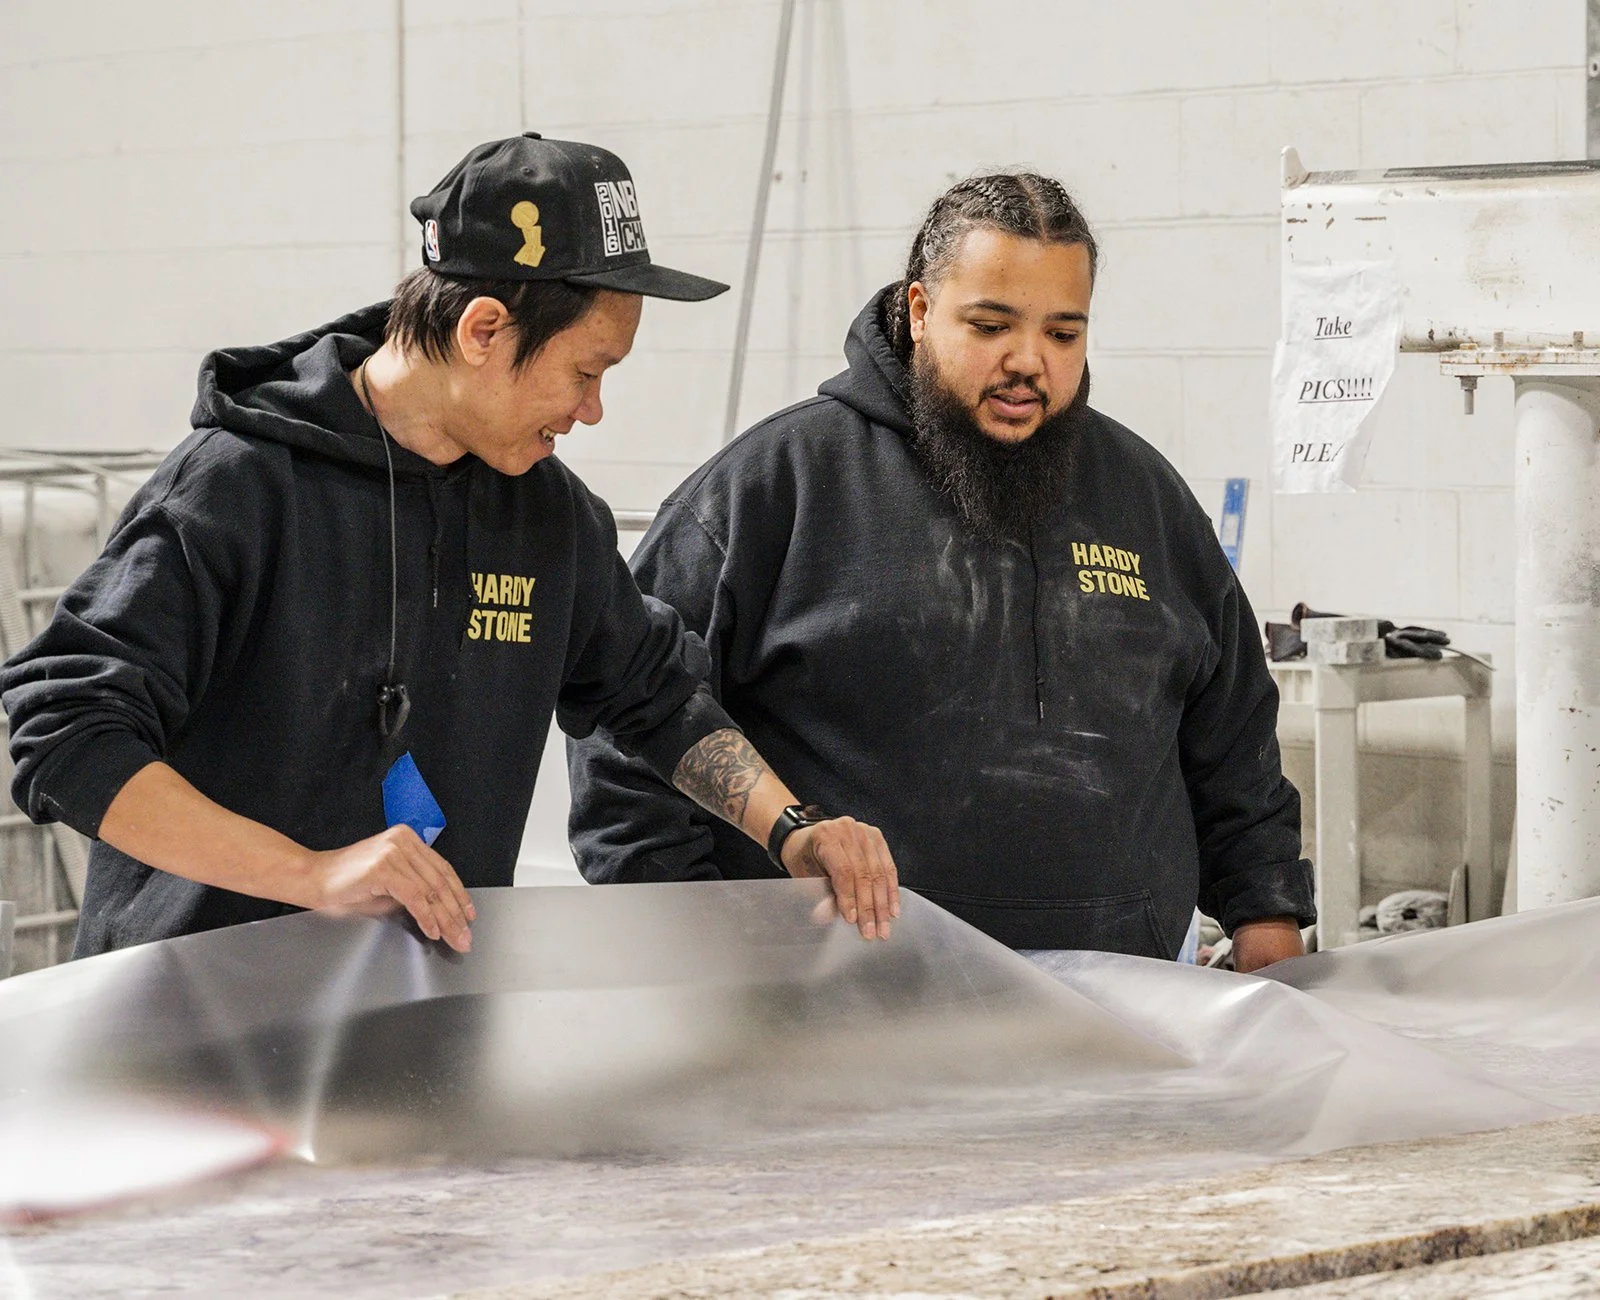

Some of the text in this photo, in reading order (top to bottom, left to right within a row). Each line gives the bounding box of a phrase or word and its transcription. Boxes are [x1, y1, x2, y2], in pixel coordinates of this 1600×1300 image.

[597, 185, 619, 253] 2016
[1315, 316, 1353, 338] Take
[1299, 377, 1373, 401] PICS!!!!
[1071, 542, 1141, 576] HARDY
[1078, 569, 1151, 601] STONE
[467, 609, 533, 642] STONE
